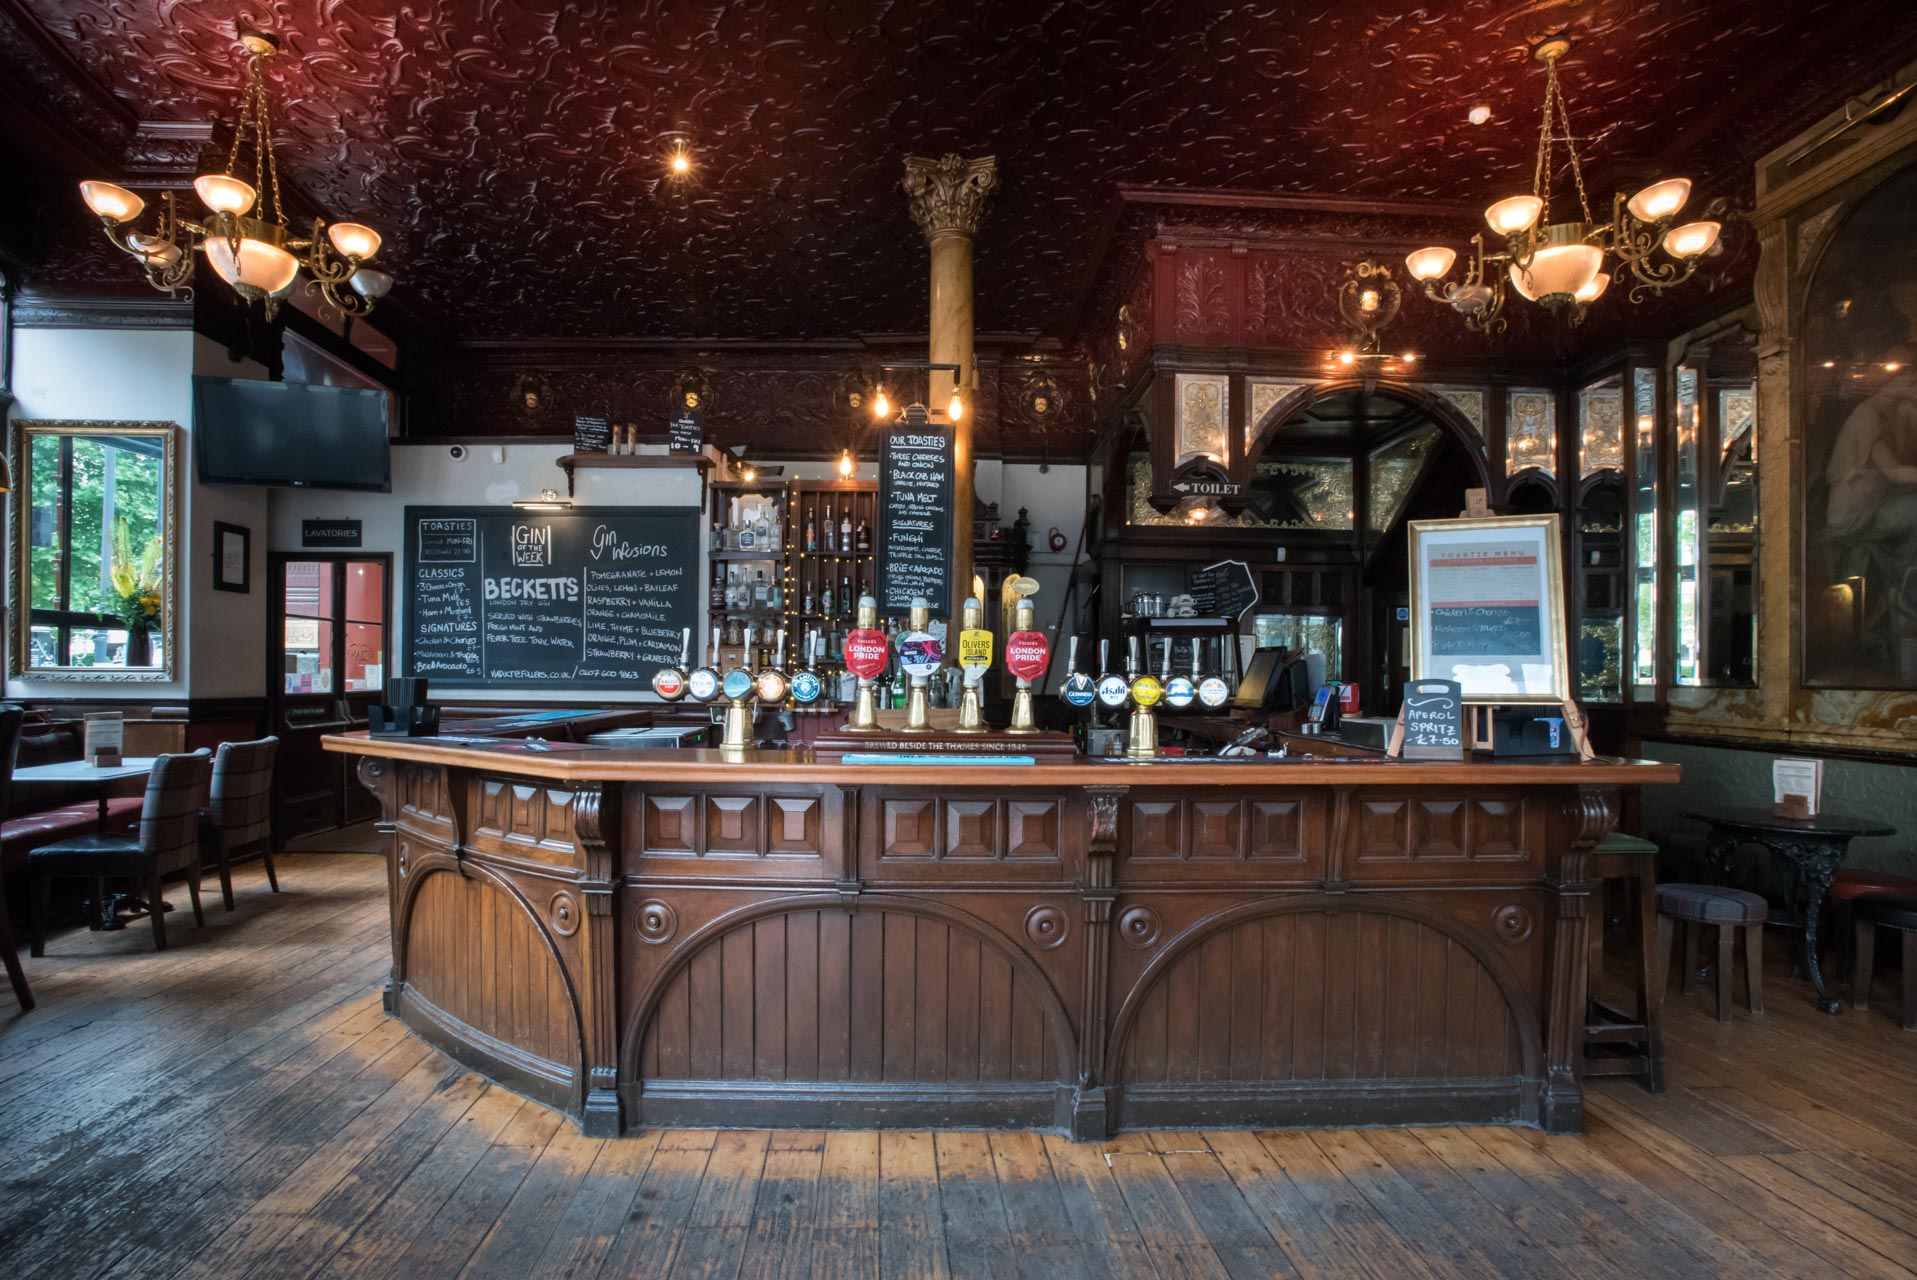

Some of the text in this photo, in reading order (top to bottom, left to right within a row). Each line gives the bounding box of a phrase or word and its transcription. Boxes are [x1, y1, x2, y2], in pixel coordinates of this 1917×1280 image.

[890, 434, 946, 448] OUR TOASTIES
[891, 452, 946, 463] THREE CHEESES
[911, 461, 935, 469] ONION
[893, 469, 915, 480] BLACK
[930, 472, 945, 482] HAM
[1191, 482, 1241, 495] TOILET
[892, 491, 938, 503] TUNA MELT
[422, 522, 473, 531] TOASTIES
[305, 529, 358, 537] LAVATORIES
[516, 525, 547, 545] GIN
[516, 551, 544, 563] WEEK
[1441, 549, 1526, 559] TOASTIE MENU
[418, 567, 465, 578] CLASSICS
[590, 569, 647, 580] POMEGRANATE
[655, 567, 683, 577] LEMON
[484, 577, 579, 601] BECKETTS
[613, 584, 638, 592] LEMON
[644, 583, 679, 592] BAYLEAF
[889, 587, 925, 597] CHICKEN
[420, 592, 461, 603] Tuna Melt
[587, 595, 631, 607] RASPBERRY
[422, 608, 439, 617] Ham
[444, 606, 472, 615] Mustard
[487, 612, 516, 621] SERVED
[517, 613, 533, 621] WITH
[586, 608, 615, 617] ORANGE
[420, 621, 478, 633] SIGNATURES
[486, 621, 543, 632] FRESH MINT AND
[610, 623, 634, 633] THYME
[641, 626, 682, 640] BLUEBERRY
[486, 633, 575, 648] FEVER TREE TONIC WATER
[619, 636, 638, 647] PLUM
[642, 639, 682, 652] CARDAMON
[962, 639, 990, 649] OLIVERS
[586, 648, 634, 661] STRAWBERRY
[848, 645, 885, 653] LONDON
[965, 648, 987, 656] ISLAND
[1010, 647, 1046, 655] LONDON
[853, 652, 880, 660] PRIDE
[578, 668, 600, 676] 0207
[601, 669, 617, 677] 600
[619, 670, 639, 679] 1863
[1101, 685, 1126, 695] Asahi
[1408, 709, 1456, 720] APEROL
[1410, 721, 1456, 736] SPRITZ
[864, 741, 1027, 751] BREWED BESIDE THE THAMES SINCE 1845
